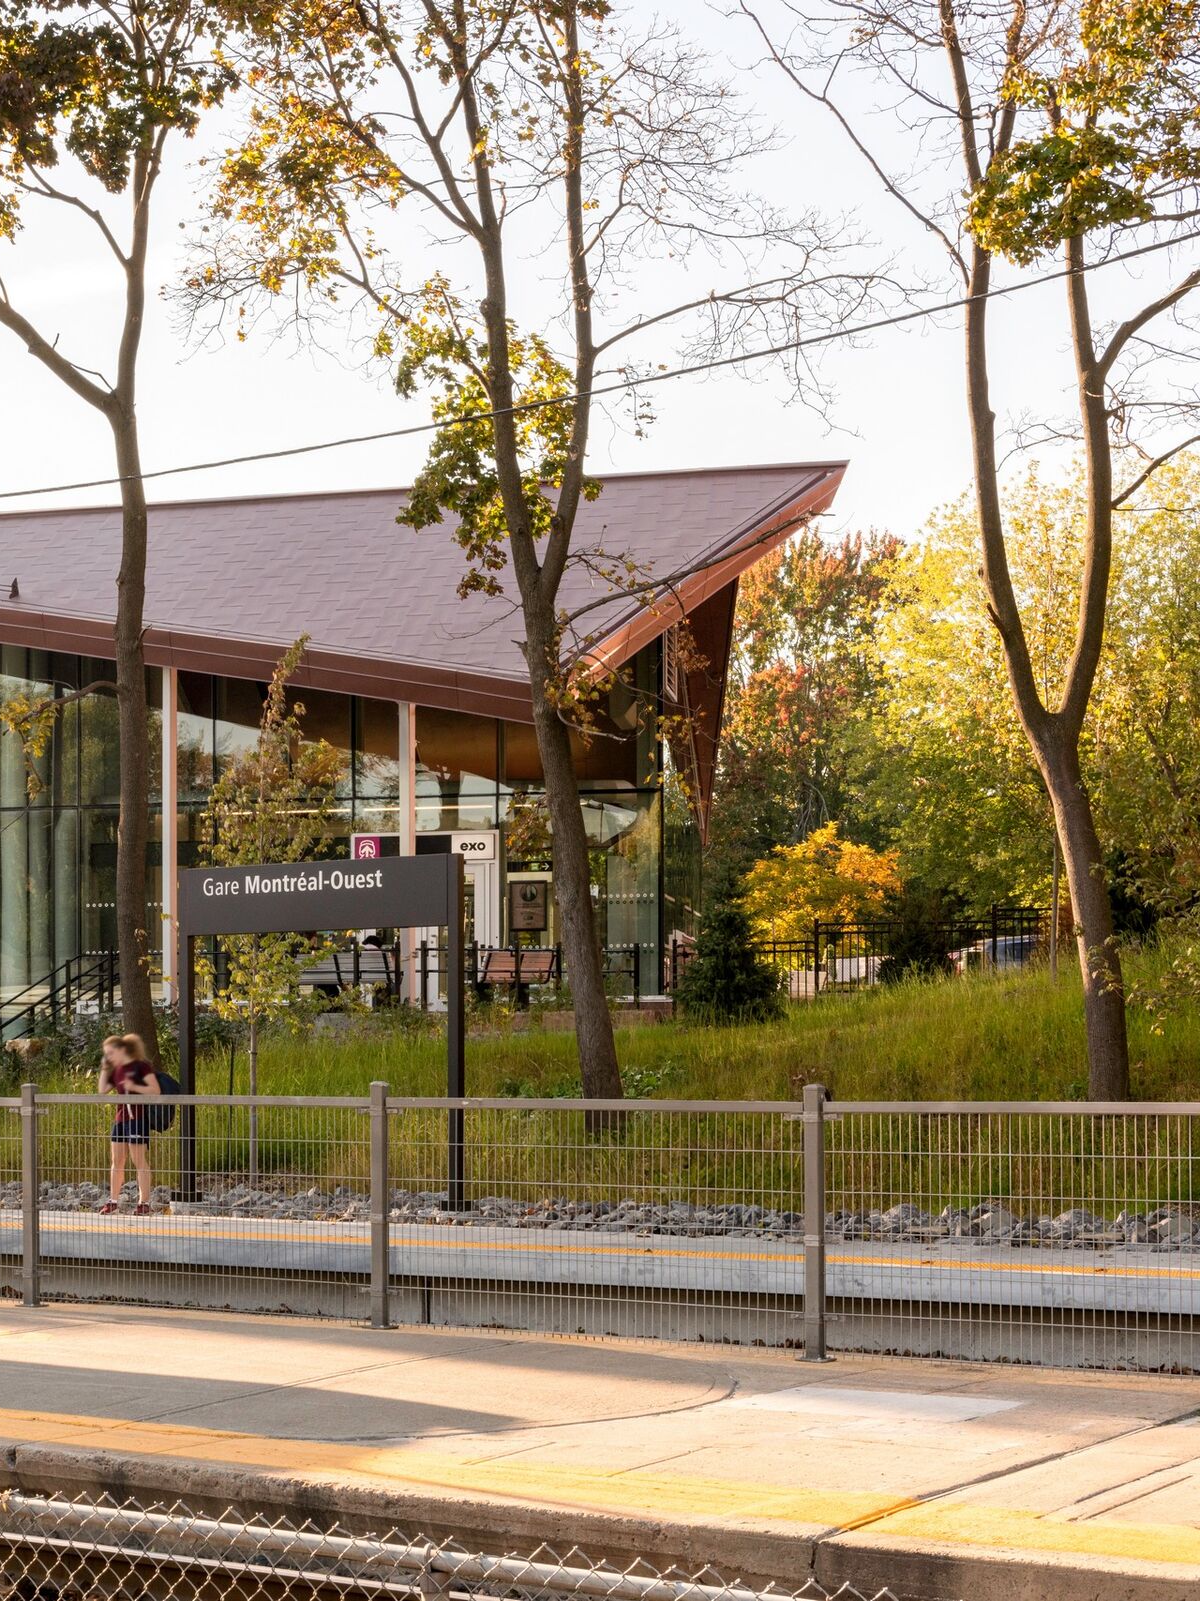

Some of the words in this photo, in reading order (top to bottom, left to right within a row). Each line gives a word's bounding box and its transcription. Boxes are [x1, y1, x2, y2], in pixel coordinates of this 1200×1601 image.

[459, 842, 486, 851] exo
[202, 877, 240, 896] Gare
[245, 869, 383, 894] Montréal-Ouest
